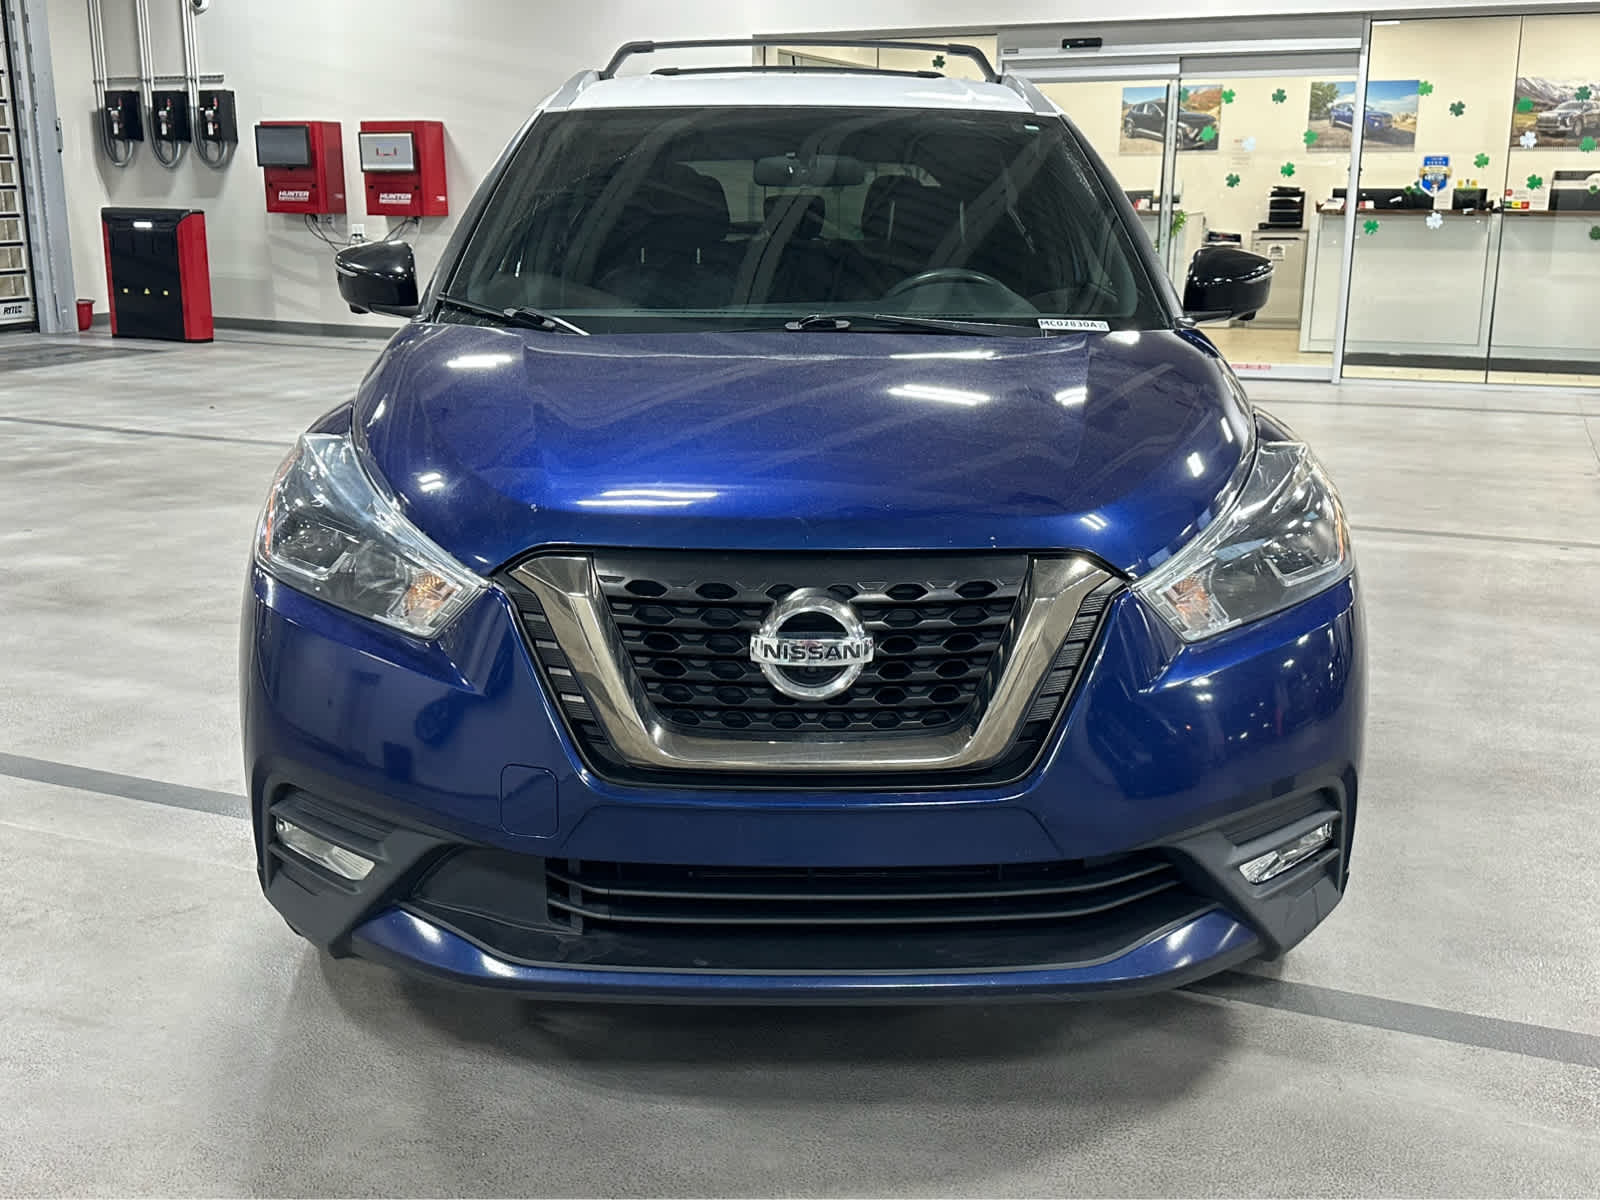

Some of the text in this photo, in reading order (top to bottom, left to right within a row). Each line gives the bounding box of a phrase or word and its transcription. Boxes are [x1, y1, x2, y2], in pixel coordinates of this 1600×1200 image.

[279, 190, 309, 198] HUNTER
[380, 193, 411, 201] HUNTER
[763, 644, 860, 660] NISSAN
